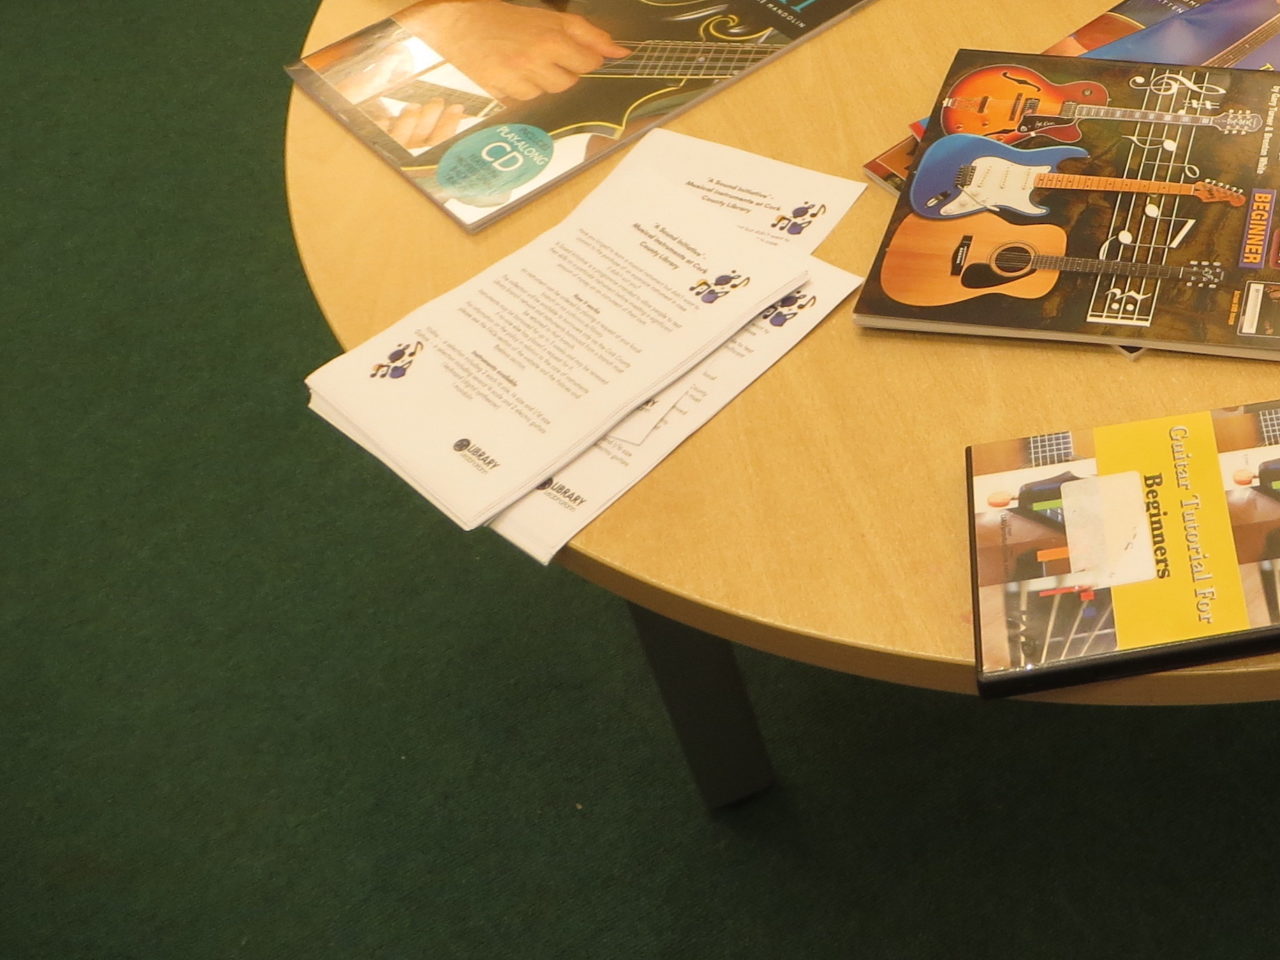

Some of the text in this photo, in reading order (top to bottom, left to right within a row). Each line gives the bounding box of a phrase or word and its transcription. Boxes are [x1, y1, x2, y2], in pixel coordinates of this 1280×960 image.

[766, 2, 806, 29] MANDOLIN
[1268, 92, 1280, 106] Gary
[1265, 106, 1277, 125] Turner
[481, 141, 524, 171] CD
[496, 126, 549, 165] PLAY-ALONG
[1256, 157, 1267, 173] White
[686, 180, 714, 192] Musical
[764, 203, 780, 211] Cork
[715, 180, 737, 189] Sound
[701, 195, 751, 214] County Library
[659, 227, 680, 240] Sound
[1242, 193, 1271, 263] BEGINNER
[633, 223, 656, 239] Musical
[693, 263, 708, 274] Cork
[639, 241, 659, 256] County
[659, 254, 679, 270] Library
[467, 444, 501, 470] LIBRARY
[550, 482, 587, 506] LIBRARY
[1144, 473, 1171, 579] Beginners
[1169, 426, 1216, 624] Guitar Tutorial For
